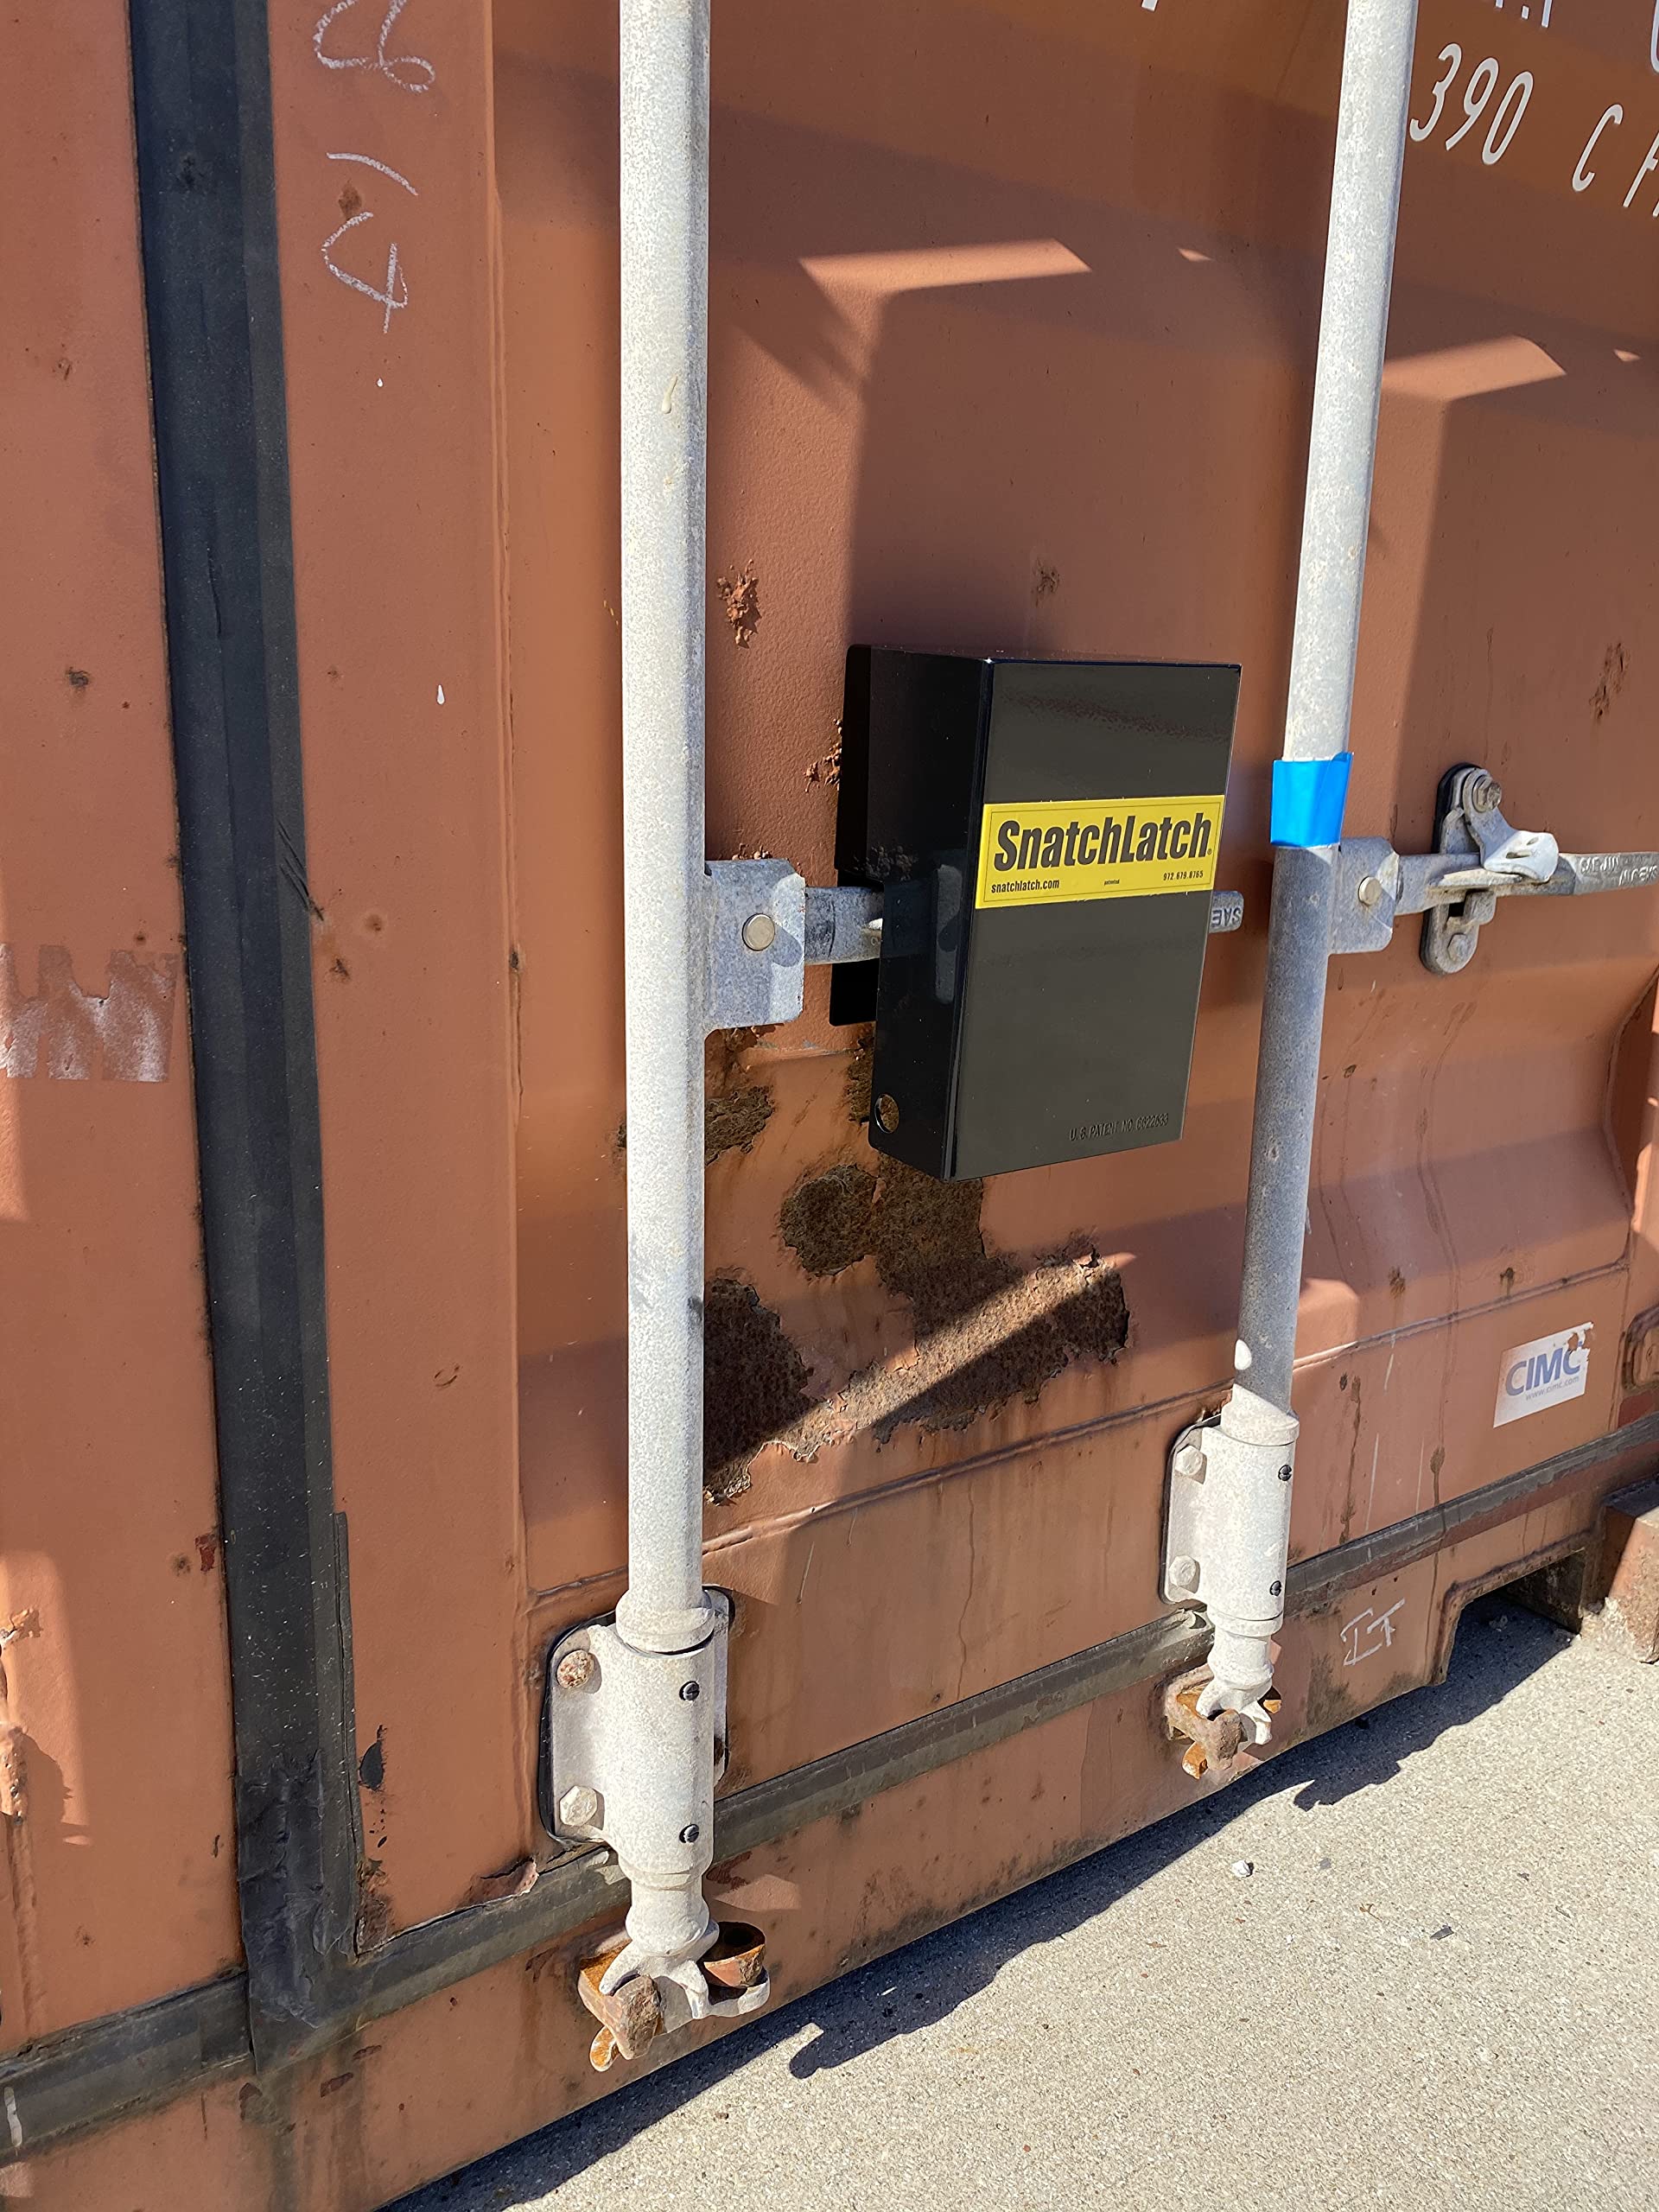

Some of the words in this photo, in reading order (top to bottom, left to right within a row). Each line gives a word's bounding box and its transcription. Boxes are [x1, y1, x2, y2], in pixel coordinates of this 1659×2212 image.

[1409, 43, 1534, 165] 390
[994, 812, 1211, 872] SnatchLatch
[990, 878, 1060, 893] snatchlatch.com
[1088, 1121, 1120, 1139] PATENT
